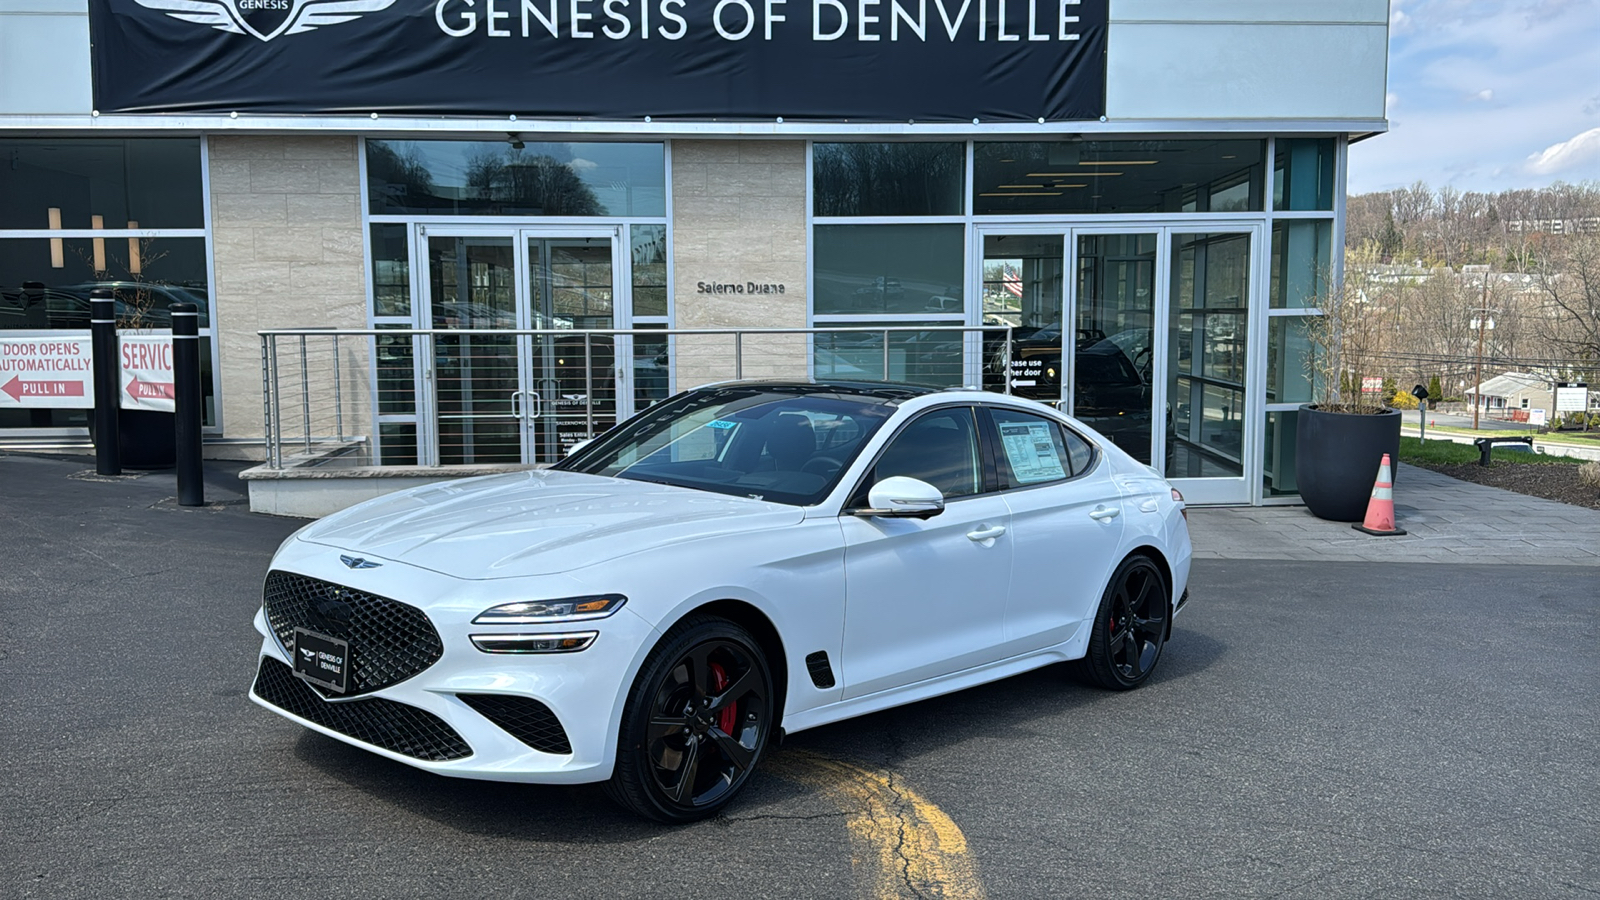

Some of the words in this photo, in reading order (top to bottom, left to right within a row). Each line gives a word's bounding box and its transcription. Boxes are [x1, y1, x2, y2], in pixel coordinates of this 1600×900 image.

[239, 0, 288, 10] GENESIS
[435, 0, 687, 40] GENESIS
[713, 0, 786, 41] OF
[812, 0, 1081, 42] DENVILLE
[697, 281, 744, 294] Salerno
[747, 281, 785, 294] Duane
[3, 343, 37, 356] DOOR
[40, 342, 80, 355] OPENS
[122, 342, 173, 371] SERVIC
[0, 358, 91, 371] UTOMATICALLY
[1023, 368, 1042, 376] door
[22, 383, 50, 394] PULL
[53, 383, 66, 394] IN
[138, 383, 157, 396] PULL
